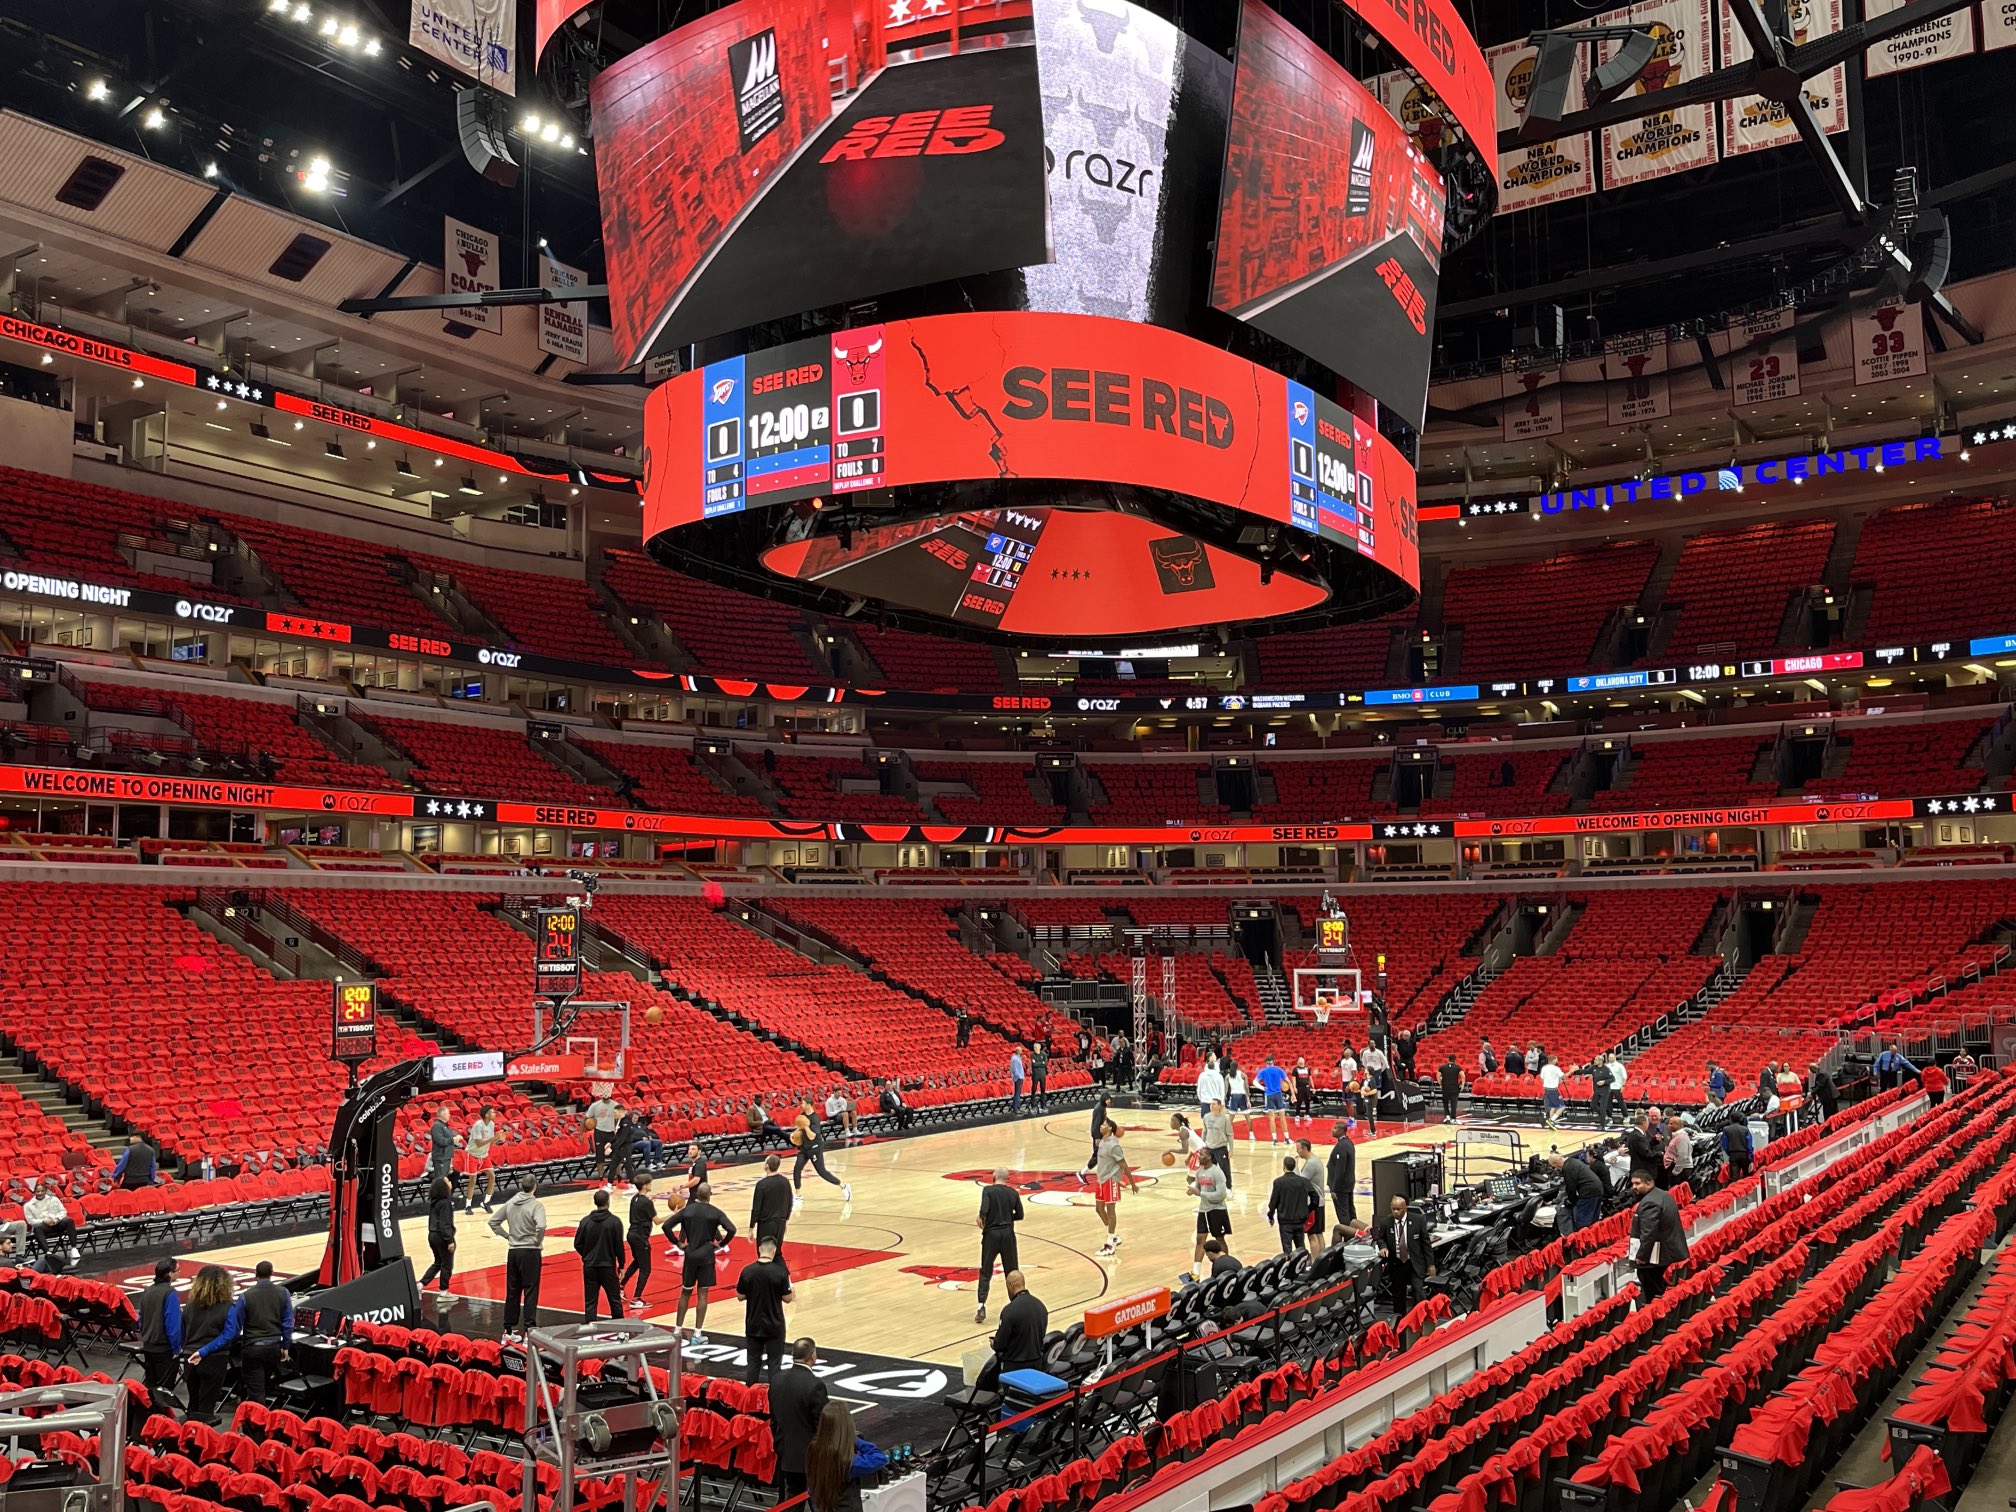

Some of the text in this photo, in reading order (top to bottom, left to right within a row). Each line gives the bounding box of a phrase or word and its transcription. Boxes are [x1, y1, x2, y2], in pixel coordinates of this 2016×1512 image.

[422, 6, 482, 45] UNITED
[421, 22, 481, 59] CENTER
[1413, 0, 1456, 76] RED
[1887, 30, 1951, 53] CHAMPIONS
[1894, 46, 1938, 64] 1990-91
[843, 104, 994, 137] SEE
[1642, 114, 1671, 130] NBA
[1632, 124, 1682, 144] WORLD
[818, 127, 1006, 163] RED
[1528, 145, 1554, 160] NBA
[1616, 130, 1700, 160] CHAMPIONS
[1518, 154, 1564, 174] WORLD
[1066, 150, 1154, 197] razr
[1503, 162, 1581, 190] CHAMPIONS
[456, 229, 488, 248] CHICAGO
[461, 241, 484, 256] BULLS
[550, 267, 578, 283] CHICAGO
[553, 276, 574, 287] BULLS
[544, 307, 583, 328] GENERAL
[544, 316, 584, 338] MANAGER
[1748, 322, 1776, 334] BULLS
[2, 320, 132, 366] CHICAGO BULLS
[1872, 330, 1904, 356] 33
[1861, 350, 1918, 368] SCOTTIE PIPPEN
[1750, 356, 1780, 382] 23
[752, 372, 784, 395] SEE
[786, 364, 824, 388] RED
[1736, 374, 1796, 390] MICHAEL JORDAN
[853, 397, 864, 428] 0
[1002, 366, 1235, 450] SEE RED
[1638, 400, 1654, 408] LOVE
[312, 404, 372, 430] SEE RED
[1533, 416, 1552, 424] SLOAN
[749, 404, 824, 450] 12:00 2
[1318, 418, 1352, 450] SEE RED
[719, 426, 729, 455] 0
[836, 438, 878, 457] TO 7
[837, 458, 878, 478] FOULS 0
[1300, 446, 1307, 474] 0
[707, 468, 739, 484] TO 4
[1318, 452, 1348, 495] 12:00
[1540, 437, 1942, 515] UNITED CENTER
[707, 486, 739, 504] FOULS 0
[919, 542, 968, 570] RED
[930, 538, 970, 562] SEE
[4, 572, 131, 606] OPENING NIGHT
[193, 603, 234, 623] razr
[962, 594, 1006, 616] SEE RED
[388, 634, 452, 656] SEE RED
[1876, 648, 1904, 658] TIMEOUTS
[1932, 642, 1950, 652] FOULS
[490, 654, 521, 668] razr
[1754, 657, 1822, 674] 0 CHICAGO
[1596, 674, 1644, 688] OKLAHOMA CITY
[1658, 672, 1664, 682] 0
[1689, 664, 1720, 680] 12:00
[1492, 682, 1517, 692] TIMEOUTS
[1538, 680, 1554, 688] FOULS
[993, 697, 1052, 709] SEE RED
[1186, 697, 1208, 710] 4:57
[1284, 694, 1306, 702] WIZARDS
[1392, 690, 1450, 700] BMO CLUB
[1090, 699, 1120, 710] razr
[24, 772, 274, 805] WELCOME TO OPENING NIGHT
[340, 796, 378, 812] razr
[1833, 804, 1876, 819] razr
[536, 807, 598, 826] SEE RED
[638, 816, 665, 830] razr
[1576, 808, 1769, 831] WELCOME TO OPENING NIGHT
[1204, 829, 1237, 842] razr
[1272, 826, 1339, 840] SEE RED
[1506, 821, 1538, 834] razr
[547, 915, 575, 931] 12:00
[1323, 921, 1345, 932] 12:00
[546, 932, 572, 958] 24
[1322, 930, 1342, 947] 24
[550, 964, 576, 972] TISSOT
[344, 987, 370, 1001] 12:00
[345, 1002, 365, 1020] 24
[348, 1024, 374, 1032] TISSOT
[452, 1061, 484, 1071] SEE RED
[380, 1163, 394, 1238] coinbase
[347, 1304, 404, 1325] RIZON
[1115, 1299, 1156, 1324] GATORADE
[1728, 1460, 1732, 1468] 5
